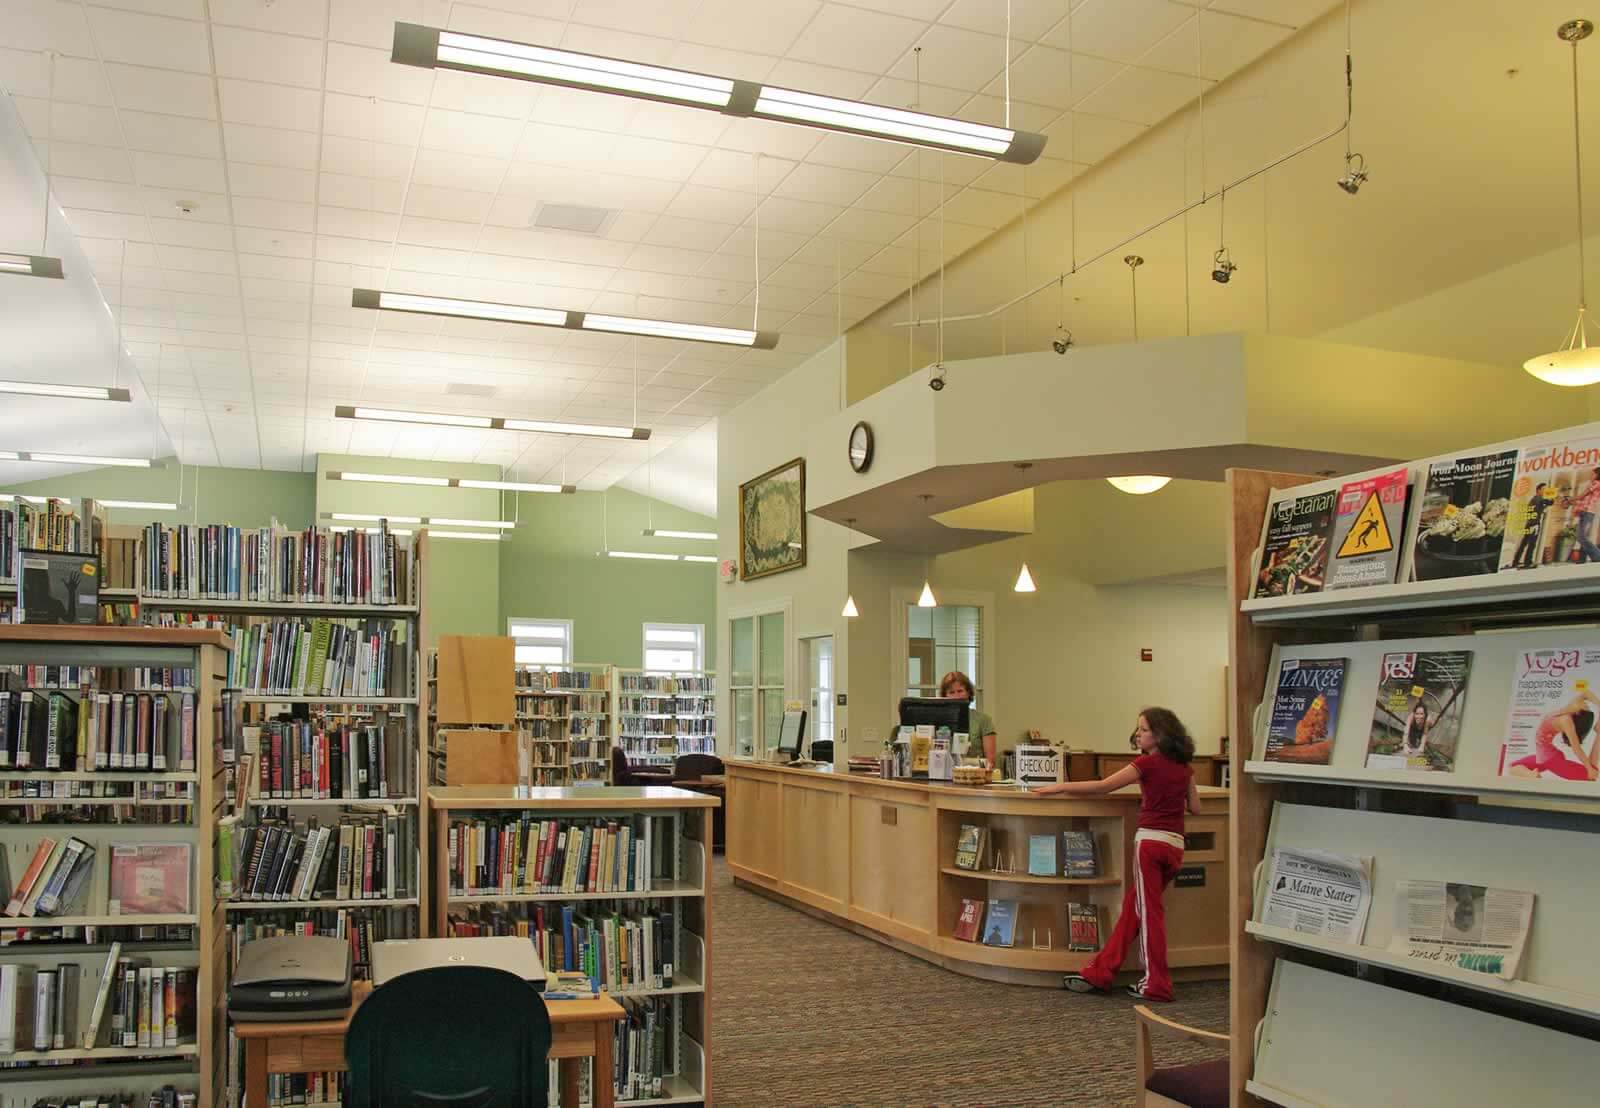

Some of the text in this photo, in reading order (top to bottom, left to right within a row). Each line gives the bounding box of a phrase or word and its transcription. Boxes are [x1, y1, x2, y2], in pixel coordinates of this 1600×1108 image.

[1454, 463, 1482, 474] Moon
[1519, 447, 1600, 473] workben
[1522, 649, 1580, 679] yoga
[1020, 759, 1059, 772] CHECK OUT
[1290, 878, 1355, 903] Maine Stater
[1071, 921, 1097, 937] RUN
